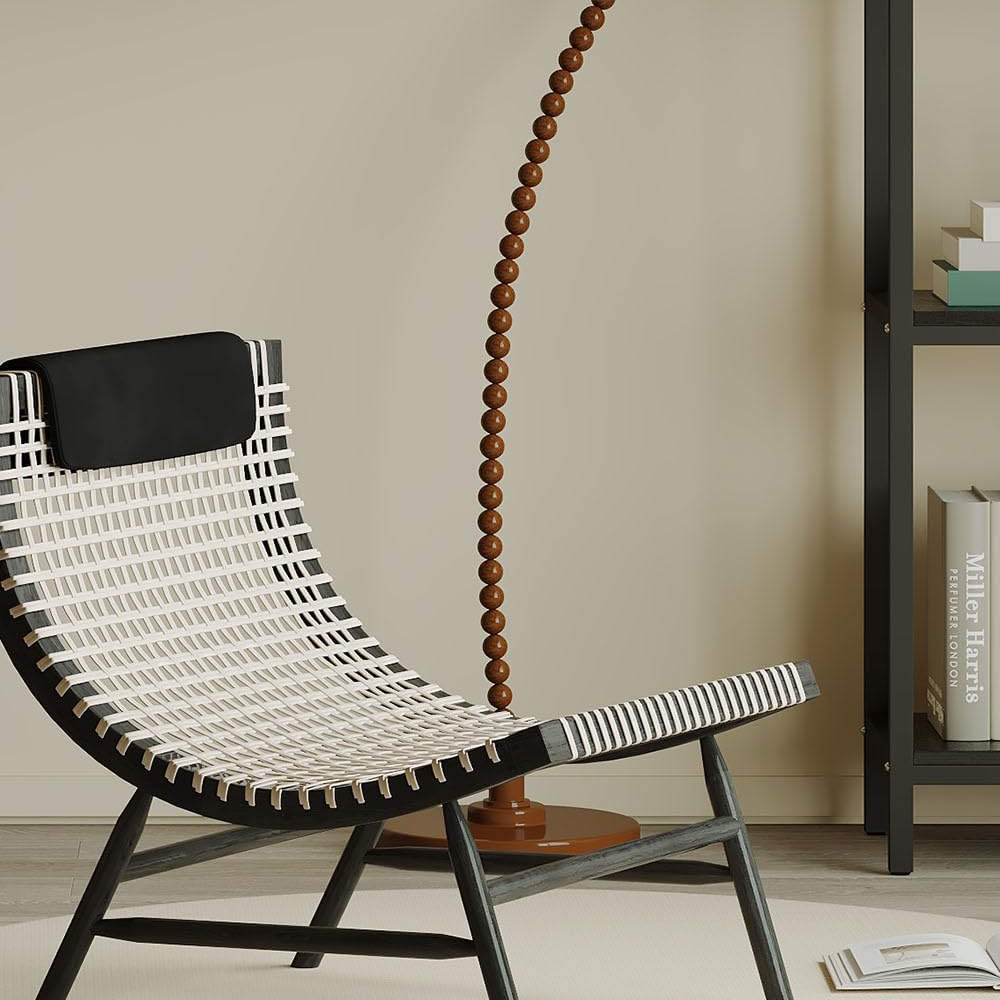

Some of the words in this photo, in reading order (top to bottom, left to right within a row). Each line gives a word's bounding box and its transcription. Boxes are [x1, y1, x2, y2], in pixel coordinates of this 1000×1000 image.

[950, 568, 959, 630] PERFUMER
[965, 552, 985, 624] Miller
[950, 634, 959, 688] LONDON
[965, 629, 985, 704] Harris
